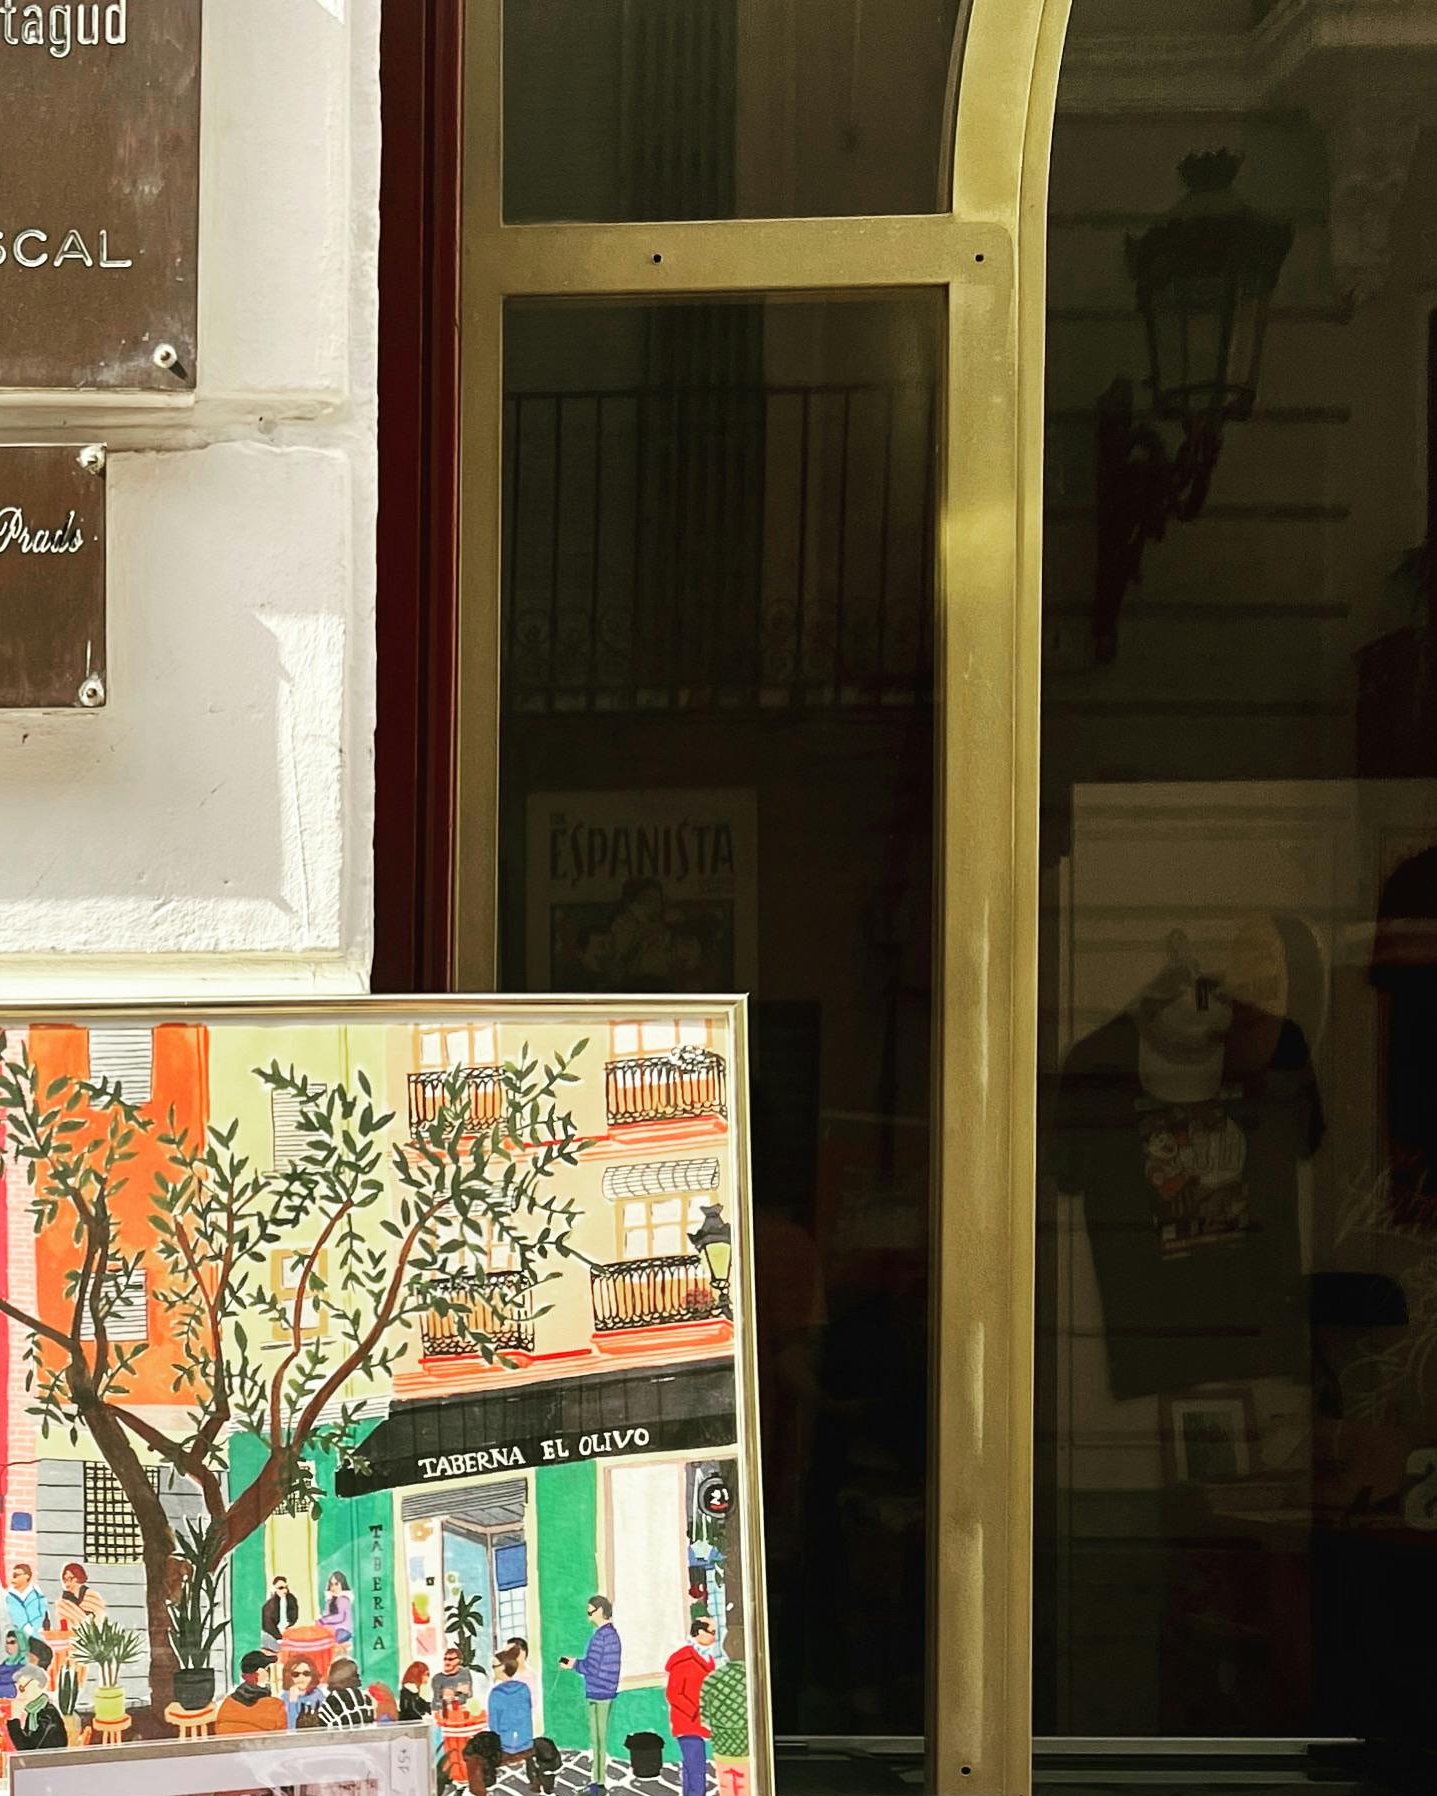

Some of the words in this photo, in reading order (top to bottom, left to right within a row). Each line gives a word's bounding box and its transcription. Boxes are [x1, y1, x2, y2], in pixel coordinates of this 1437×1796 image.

[418, 1446, 526, 1479] TABERNA
[541, 1440, 570, 1460] EL
[578, 1428, 650, 1455] OLIVO
[368, 1524, 386, 1650] TABERNA
